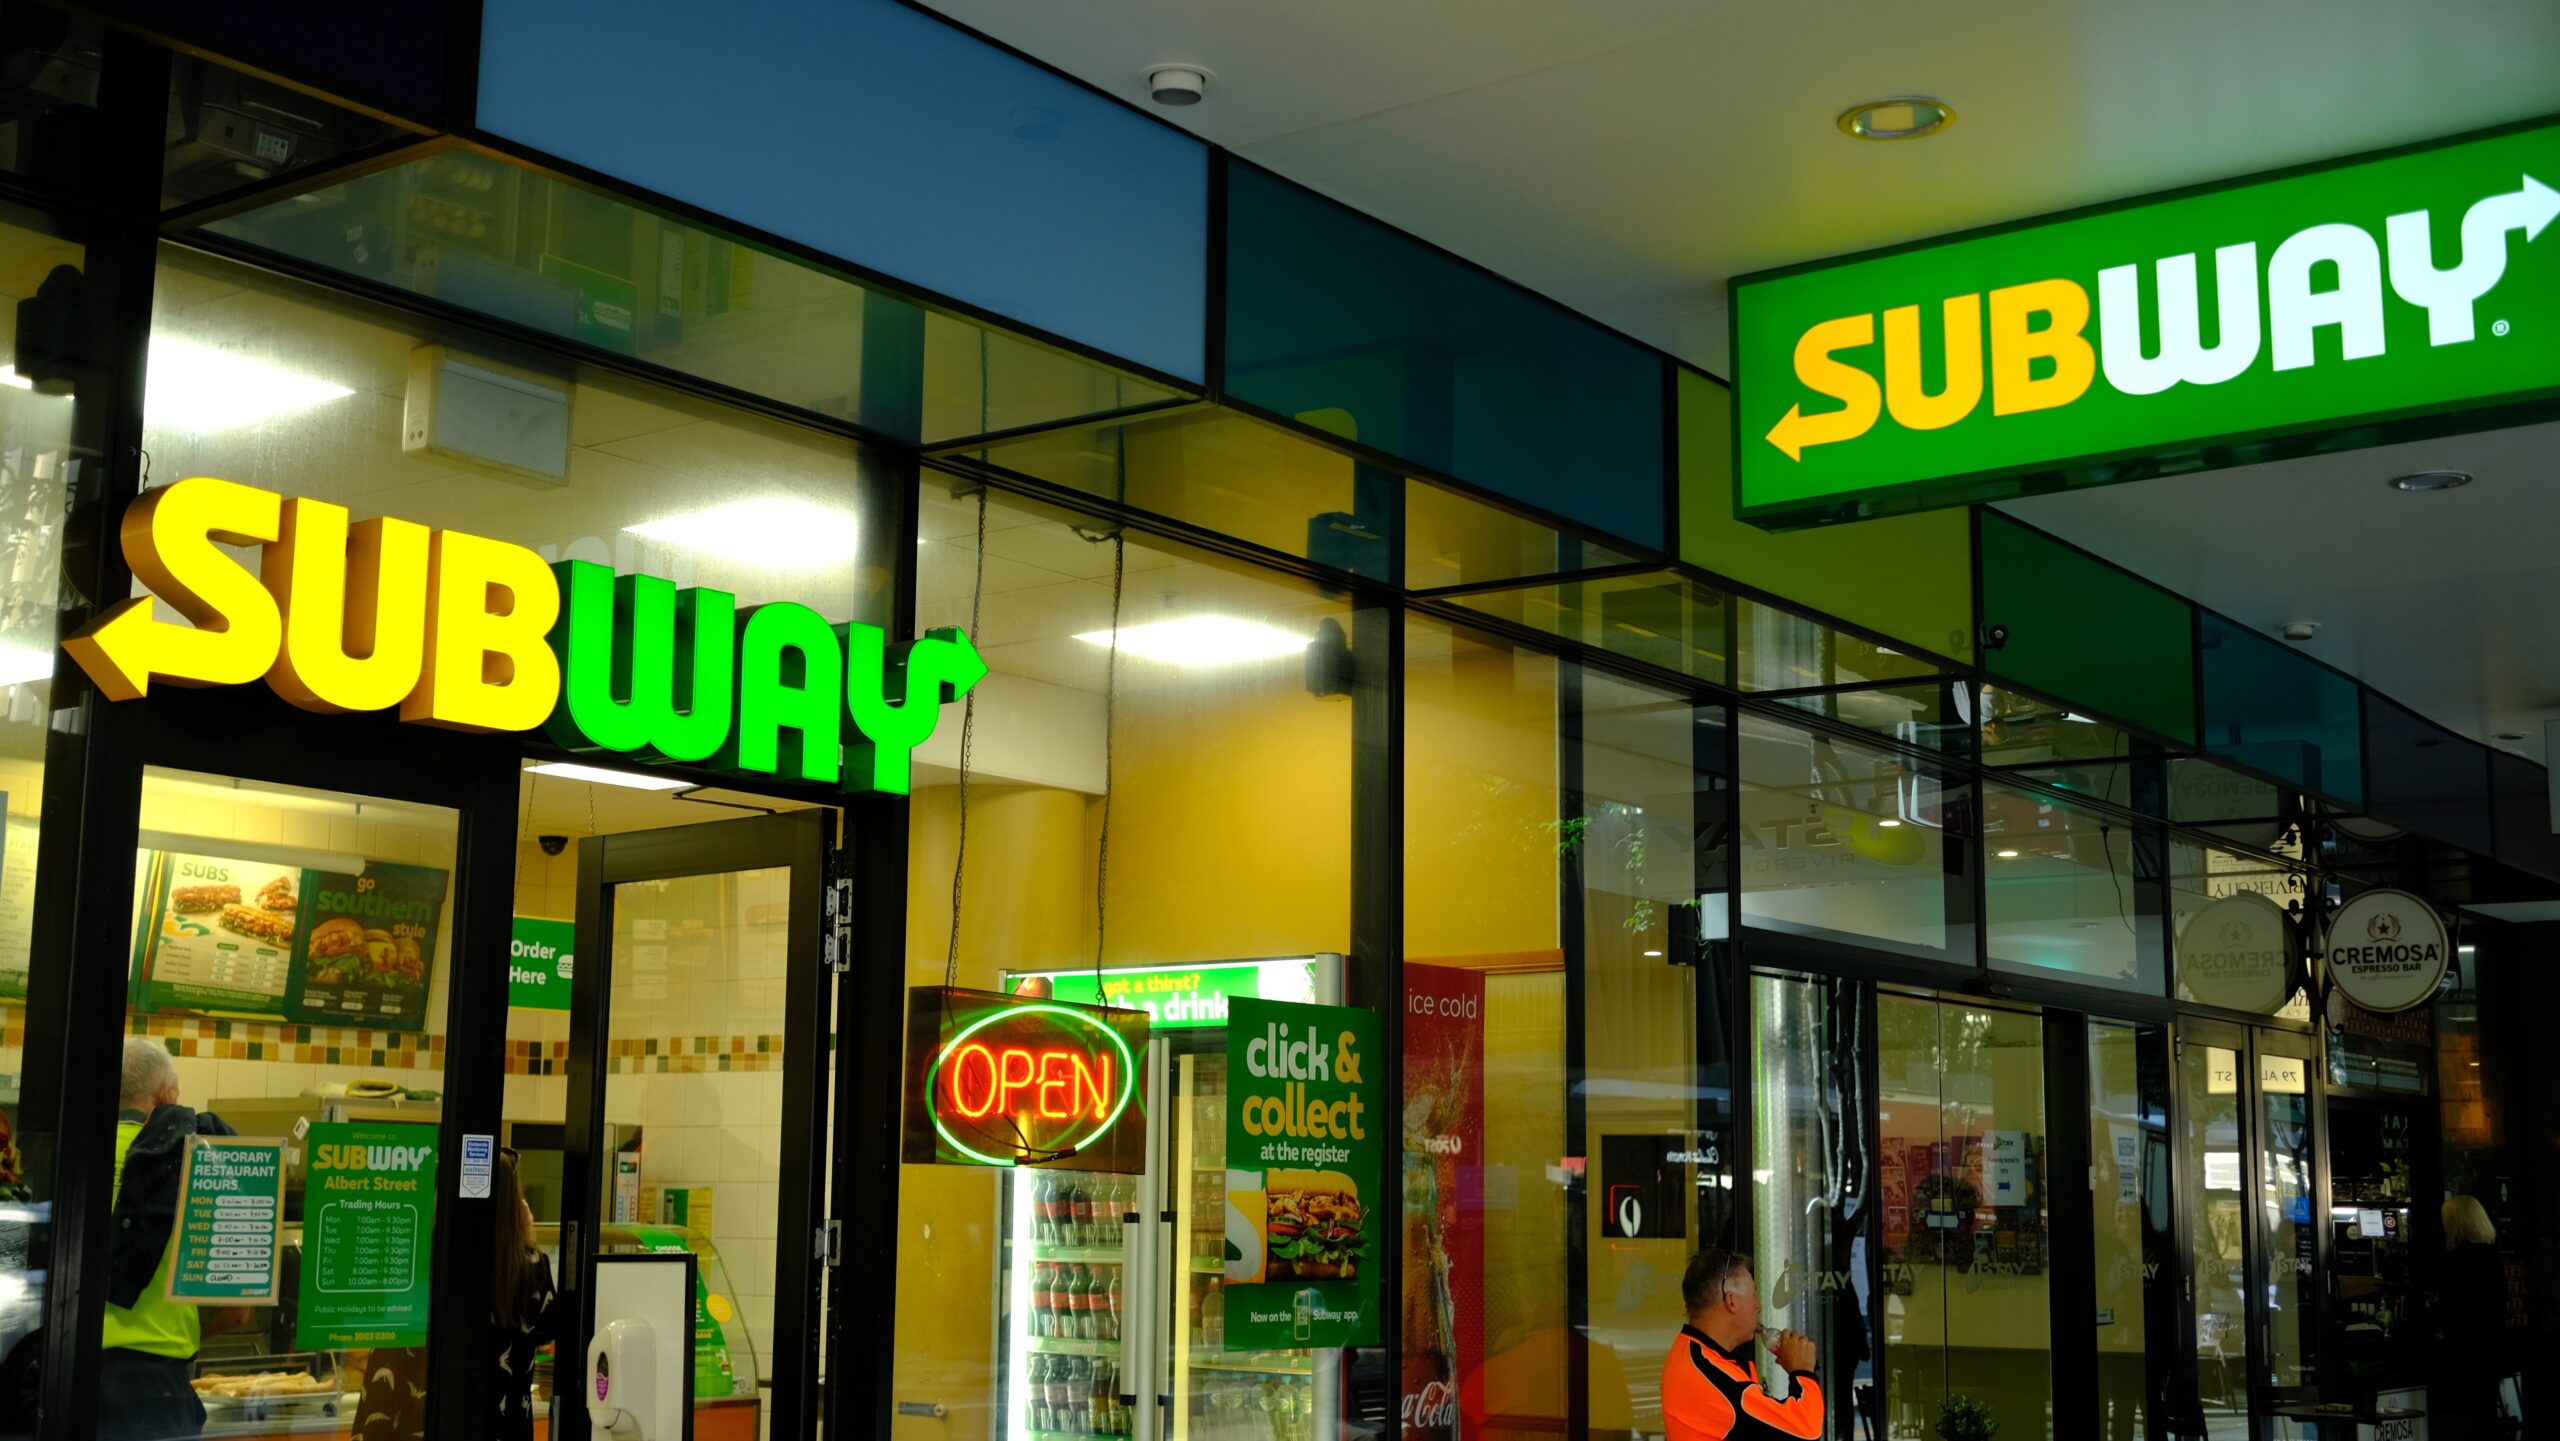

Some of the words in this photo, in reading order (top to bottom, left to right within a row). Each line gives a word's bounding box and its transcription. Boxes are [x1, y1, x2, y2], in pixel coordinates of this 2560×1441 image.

[1766, 173, 2560, 463] SUBWAY
[60, 476, 990, 796] SUBWAY
[181, 862, 230, 883] SUBS
[357, 877, 375, 893] go
[316, 889, 433, 922] southern
[393, 923, 427, 941] style
[511, 939, 556, 960] Order
[2332, 944, 2438, 965] CREMOSA
[509, 966, 546, 985] Here
[2352, 964, 2400, 974] ESPRESSO
[2402, 963, 2421, 972] BAR
[1104, 980, 1130, 997] got
[1133, 978, 1144, 993] a
[1147, 973, 1200, 993] thirst?
[1164, 992, 1229, 1021] drink
[1409, 988, 1434, 1015] ice
[1439, 993, 1477, 1019] cold
[1246, 1022, 1329, 1082] click
[1335, 1030, 1364, 1084] &
[953, 1043, 1109, 1119] OPEN
[1242, 1081, 1366, 1140] collect
[352, 1131, 386, 1140] Welcome
[196, 1150, 272, 1164] TEMPORARY
[312, 1144, 432, 1172] SUBWAY
[1260, 1143, 1275, 1160] at
[1276, 1141, 1300, 1161] the
[1301, 1143, 1351, 1168] register
[194, 1164, 276, 1177] RESTAURANT
[192, 1179, 239, 1191] HOURS
[324, 1175, 370, 1190] Albert
[374, 1176, 417, 1191] Street
[190, 1196, 213, 1206] MON
[339, 1199, 372, 1211] Trading
[374, 1200, 401, 1209] Hours
[193, 1209, 212, 1218] TUE
[187, 1222, 211, 1231] WED
[189, 1234, 208, 1243] THU
[191, 1247, 207, 1257] FRI
[186, 1260, 206, 1269] SAT
[182, 1273, 203, 1282] SUN
[315, 1305, 335, 1313] Public
[337, 1305, 366, 1314] Holidays
[387, 1304, 412, 1312] advised
[1250, 1311, 1269, 1323] Now
[1269, 1313, 1279, 1323] on
[1279, 1310, 1292, 1322] the
[1313, 1309, 1342, 1323] Subway
[1343, 1311, 1359, 1322] app.
[328, 1333, 353, 1341] Phone
